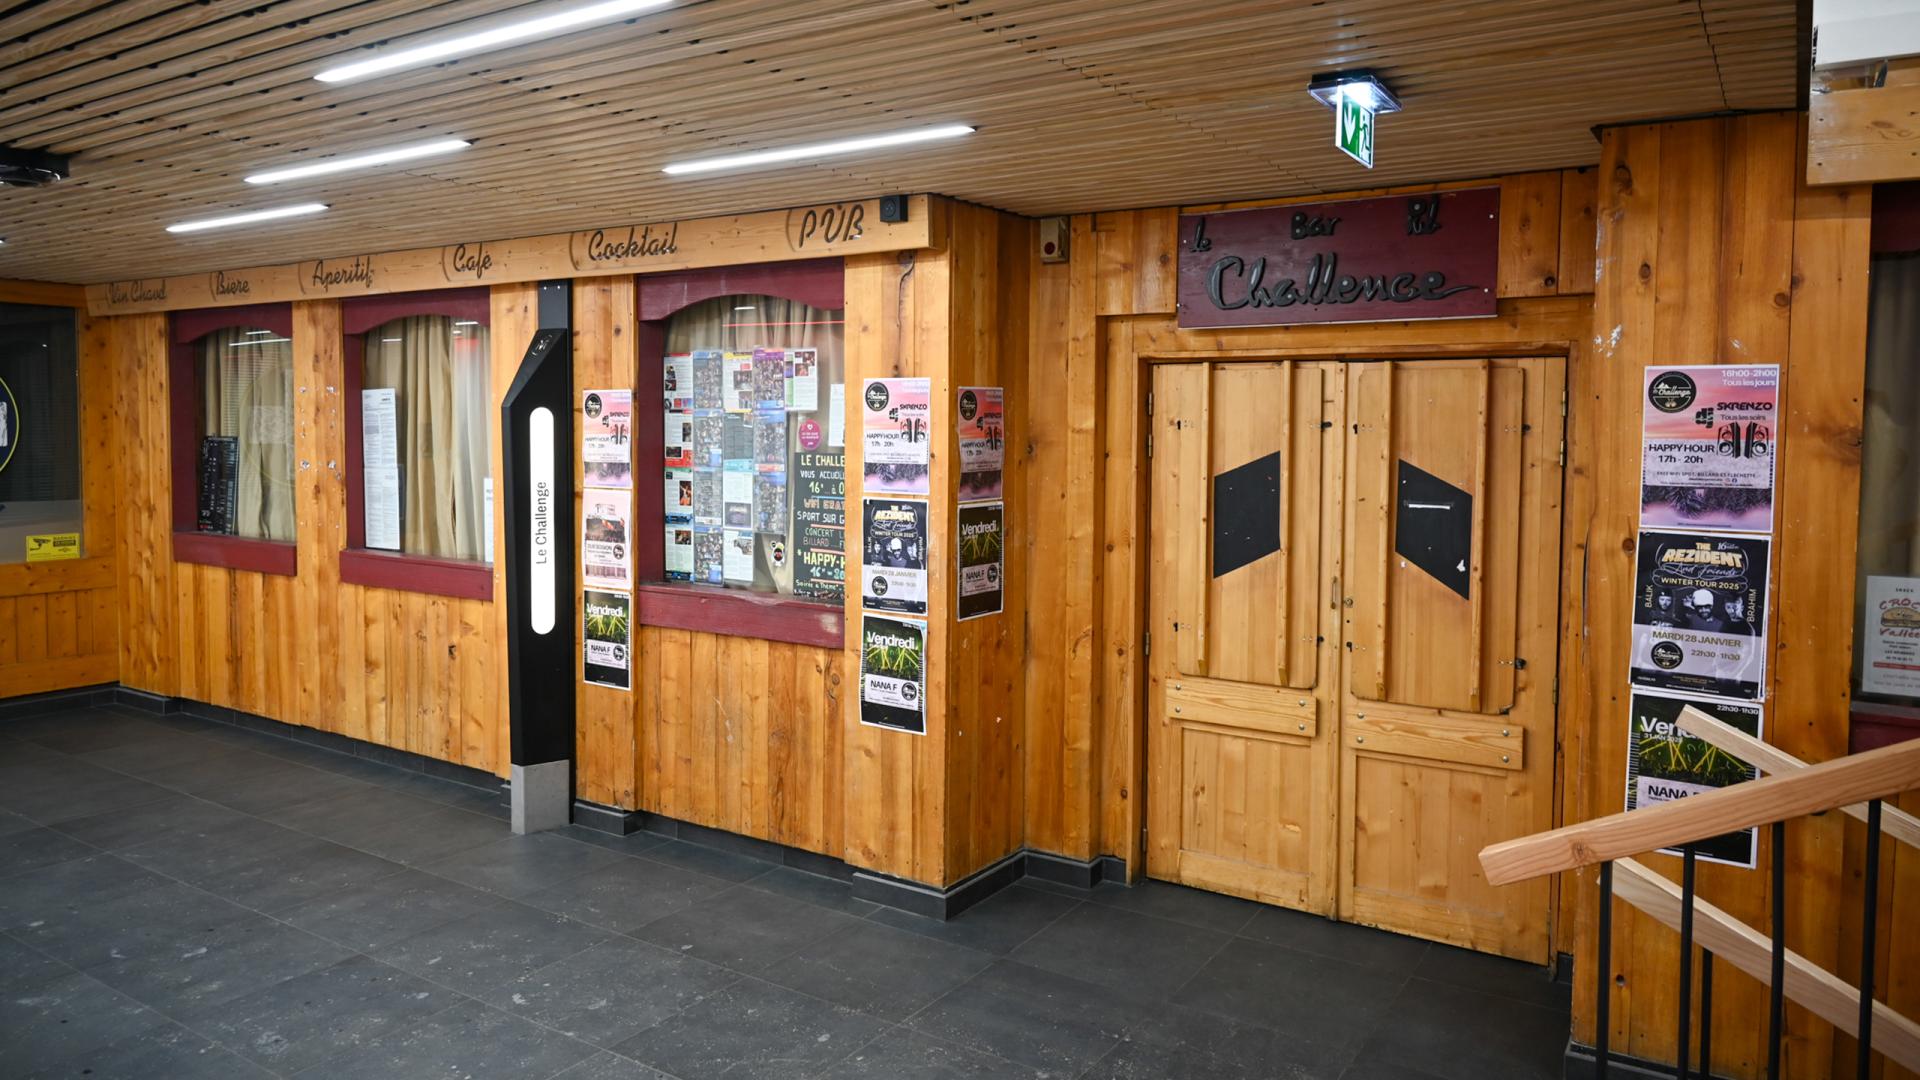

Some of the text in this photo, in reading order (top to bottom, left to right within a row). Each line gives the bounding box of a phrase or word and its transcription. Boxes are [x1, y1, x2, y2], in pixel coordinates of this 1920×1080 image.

[1291, 211, 1341, 240] Bar
[588, 222, 679, 264] Cocktail
[1754, 379, 1776, 388] jours
[1716, 401, 1773, 411] SKRENZO
[1648, 444, 1715, 453] HAPPY HOUR
[801, 454, 812, 466] LE
[1658, 455, 1676, 463] 17h
[1683, 455, 1703, 464] 20h
[800, 470, 816, 479] VOUS
[535, 481, 550, 565] Le Challenge
[797, 511, 820, 522] SPORT
[823, 512, 836, 523] SUR
[805, 528, 834, 538] CONCERT
[803, 536, 829, 548] BILLARD
[1695, 542, 1711, 550] THE
[1661, 549, 1743, 568] REZIDENT
[1660, 576, 1740, 590] WINTER TOUR 2025
[1644, 584, 1653, 608] BALIK
[1746, 588, 1758, 622] BRAHIM
[866, 630, 915, 650] Vendredi
[1651, 631, 1742, 648] MARDI 28 JANVIER
[1690, 649, 1741, 661] 22h30 1h30
[870, 679, 898, 691] NANA F
[1648, 784, 1688, 799] NANA
